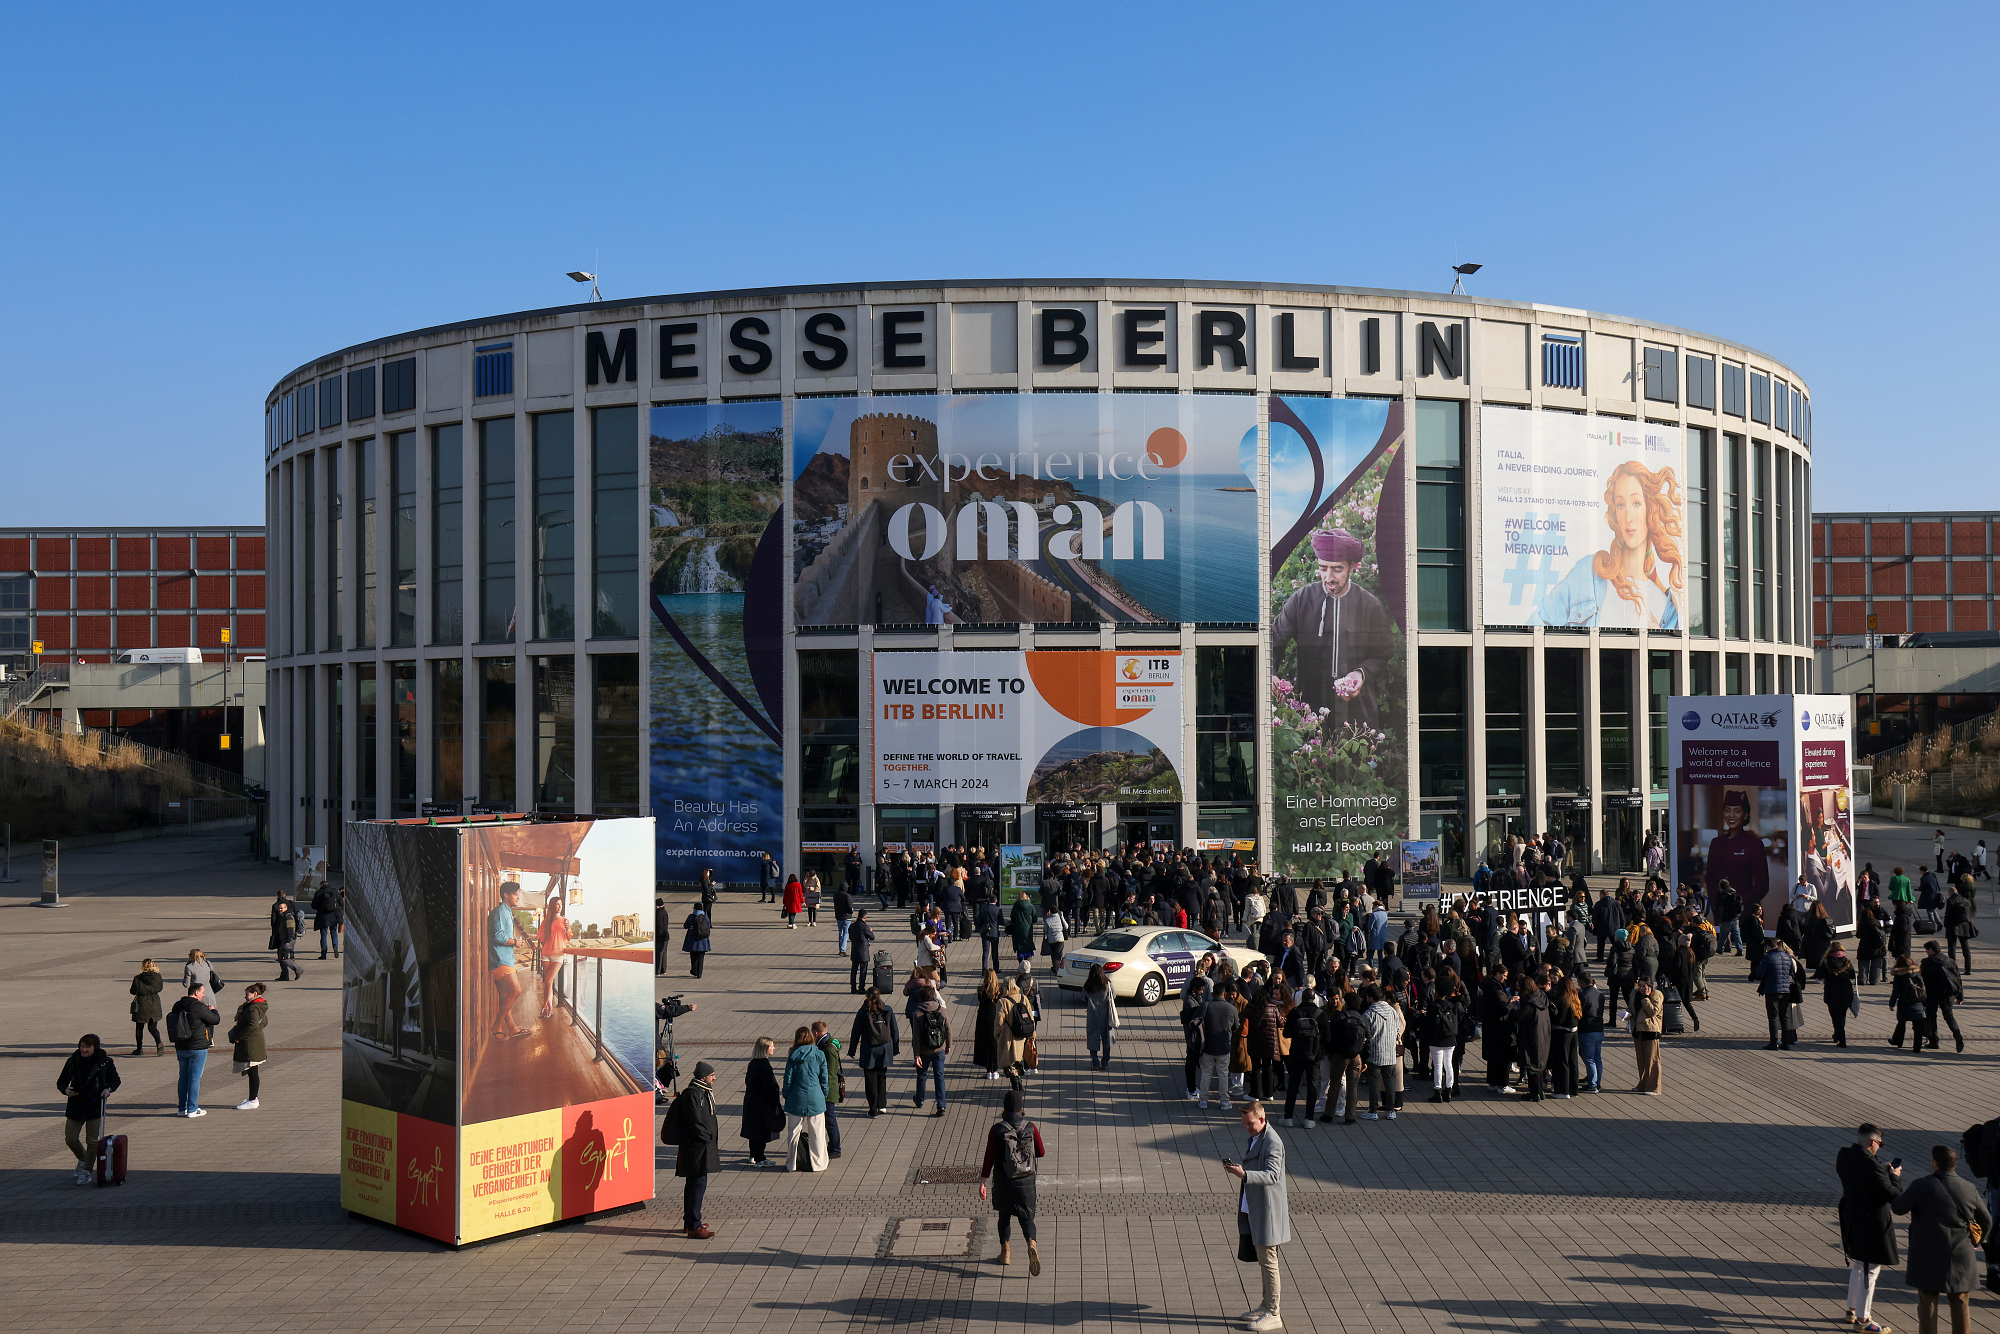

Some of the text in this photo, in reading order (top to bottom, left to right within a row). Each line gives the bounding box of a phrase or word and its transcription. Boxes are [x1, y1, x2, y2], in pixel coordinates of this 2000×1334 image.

[586, 308, 1462, 385] MESSE BERLIN
[1497, 450, 1524, 459] ITALIA.
[887, 441, 1164, 493] experience
[1497, 463, 1599, 478] A NEVER ENDING JOURNEY.
[1497, 486, 1512, 494] VISIT
[887, 500, 1164, 561] oman
[1505, 518, 1566, 532] #WELCOME
[1505, 531, 1520, 541] TO
[1505, 543, 1569, 556] MERAVIGLIA
[1148, 659, 1170, 670] ITB
[883, 678, 1025, 695] WELCOME TO
[1122, 694, 1156, 702] oman
[884, 703, 1004, 720] ITB BERLIN!
[1711, 712, 1759, 726] QATAR
[1814, 713, 1837, 727] QATAR
[883, 753, 1023, 761] DEFINE THE WORLD OF TRAVEL.
[1689, 747, 1730, 756] Welcome
[1731, 748, 1739, 756] to
[1804, 747, 1836, 758] Elevated dining
[883, 763, 932, 771] TOGETHER.
[1689, 758, 1771, 768] world of excellence
[1804, 759, 1827, 770] experience
[883, 779, 890, 789] 5
[903, 779, 910, 789] 7
[913, 779, 958, 789] MARCH
[961, 778, 989, 789] 2024
[1152, 787, 1171, 795] Berlin
[674, 799, 758, 816] Beauty Has
[1286, 794, 1397, 810] Eine Hommage
[674, 818, 758, 832] An Address
[1299, 812, 1384, 828] ans Erleben
[666, 847, 766, 858] experienceoman.om
[1292, 842, 1312, 853] Hall
[1315, 842, 1332, 852] 2.2
[1341, 841, 1373, 852] Booth
[1375, 841, 1393, 850] 201
[1167, 965, 1191, 974] oman
[496, 1136, 554, 1161] ERWARTUNGEN
[580, 1117, 637, 1191] Egypt
[524, 1154, 542, 1172] DER
[540, 1168, 551, 1184] AN
[488, 1191, 538, 1206] #ExperienceEgypt
[494, 1208, 516, 1219] HALLE
